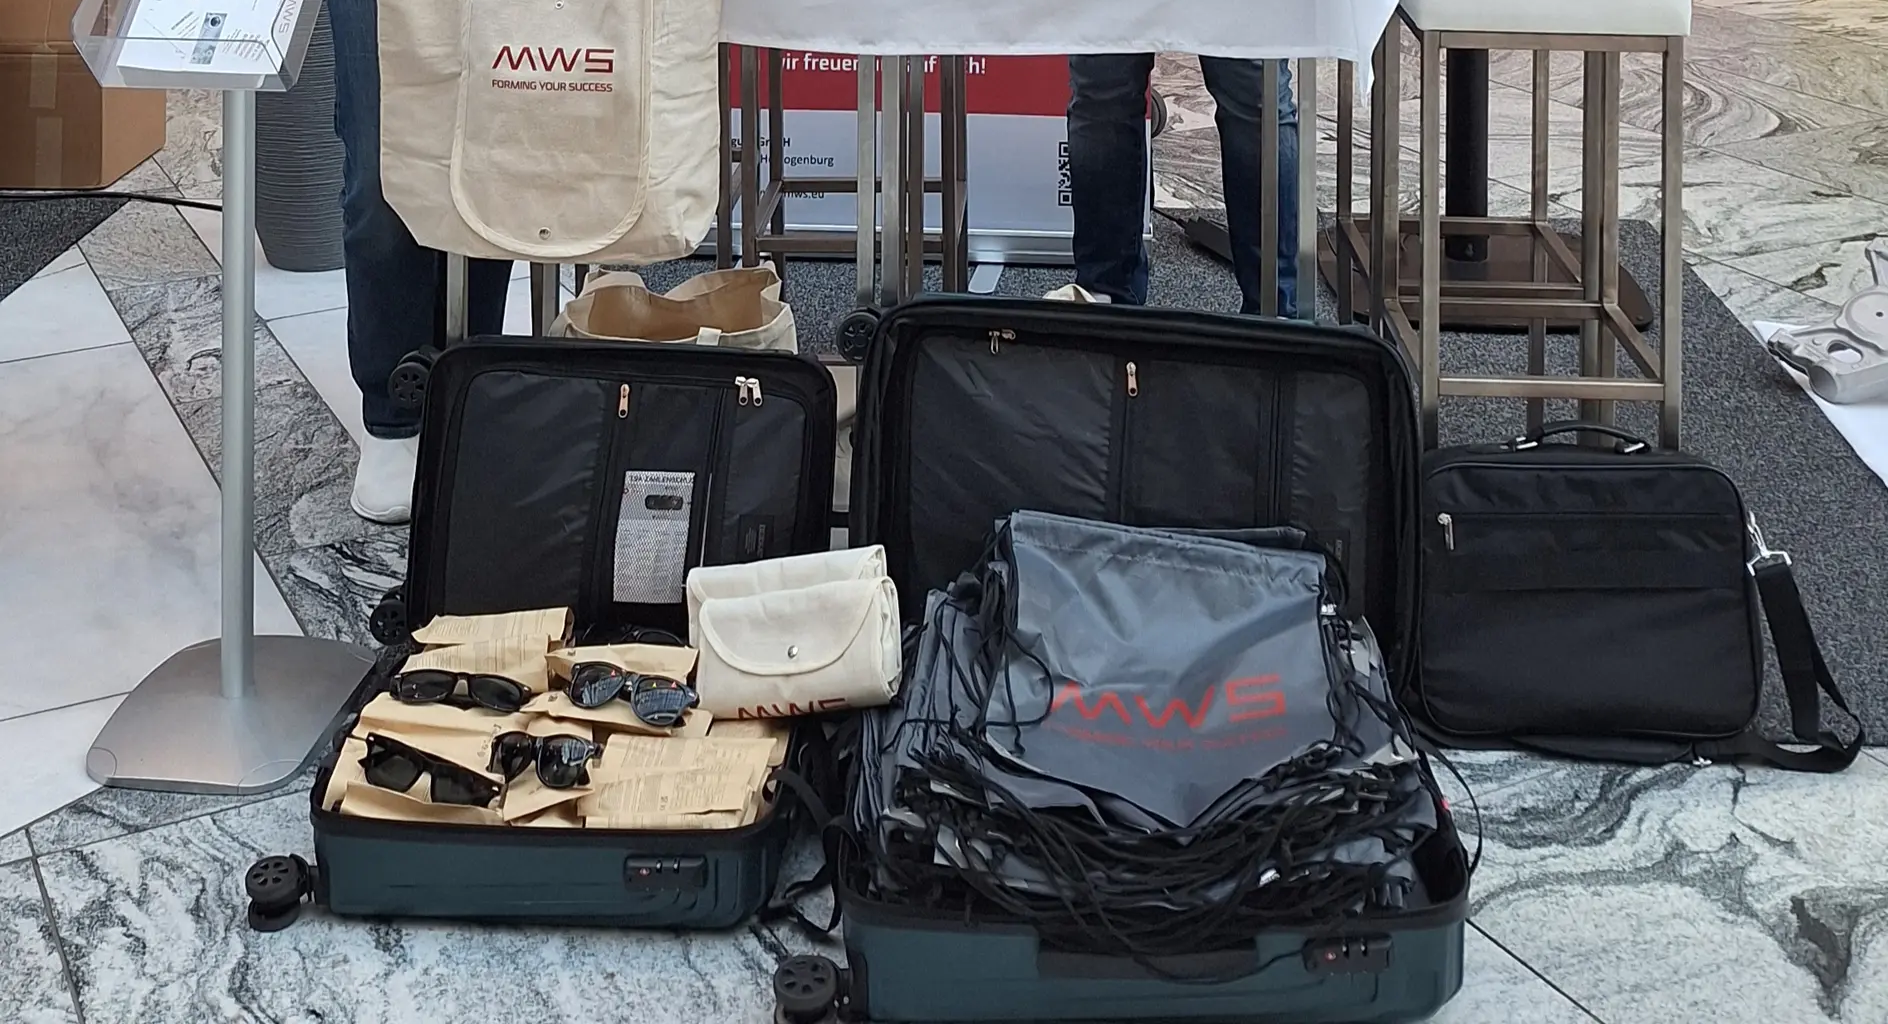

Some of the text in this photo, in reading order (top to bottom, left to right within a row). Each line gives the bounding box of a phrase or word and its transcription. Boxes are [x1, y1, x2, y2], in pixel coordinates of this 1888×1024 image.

[492, 46, 615, 73] MWS
[491, 79, 613, 92] FORMING YOUR SUCCESS
[1050, 673, 1287, 729] MWS
